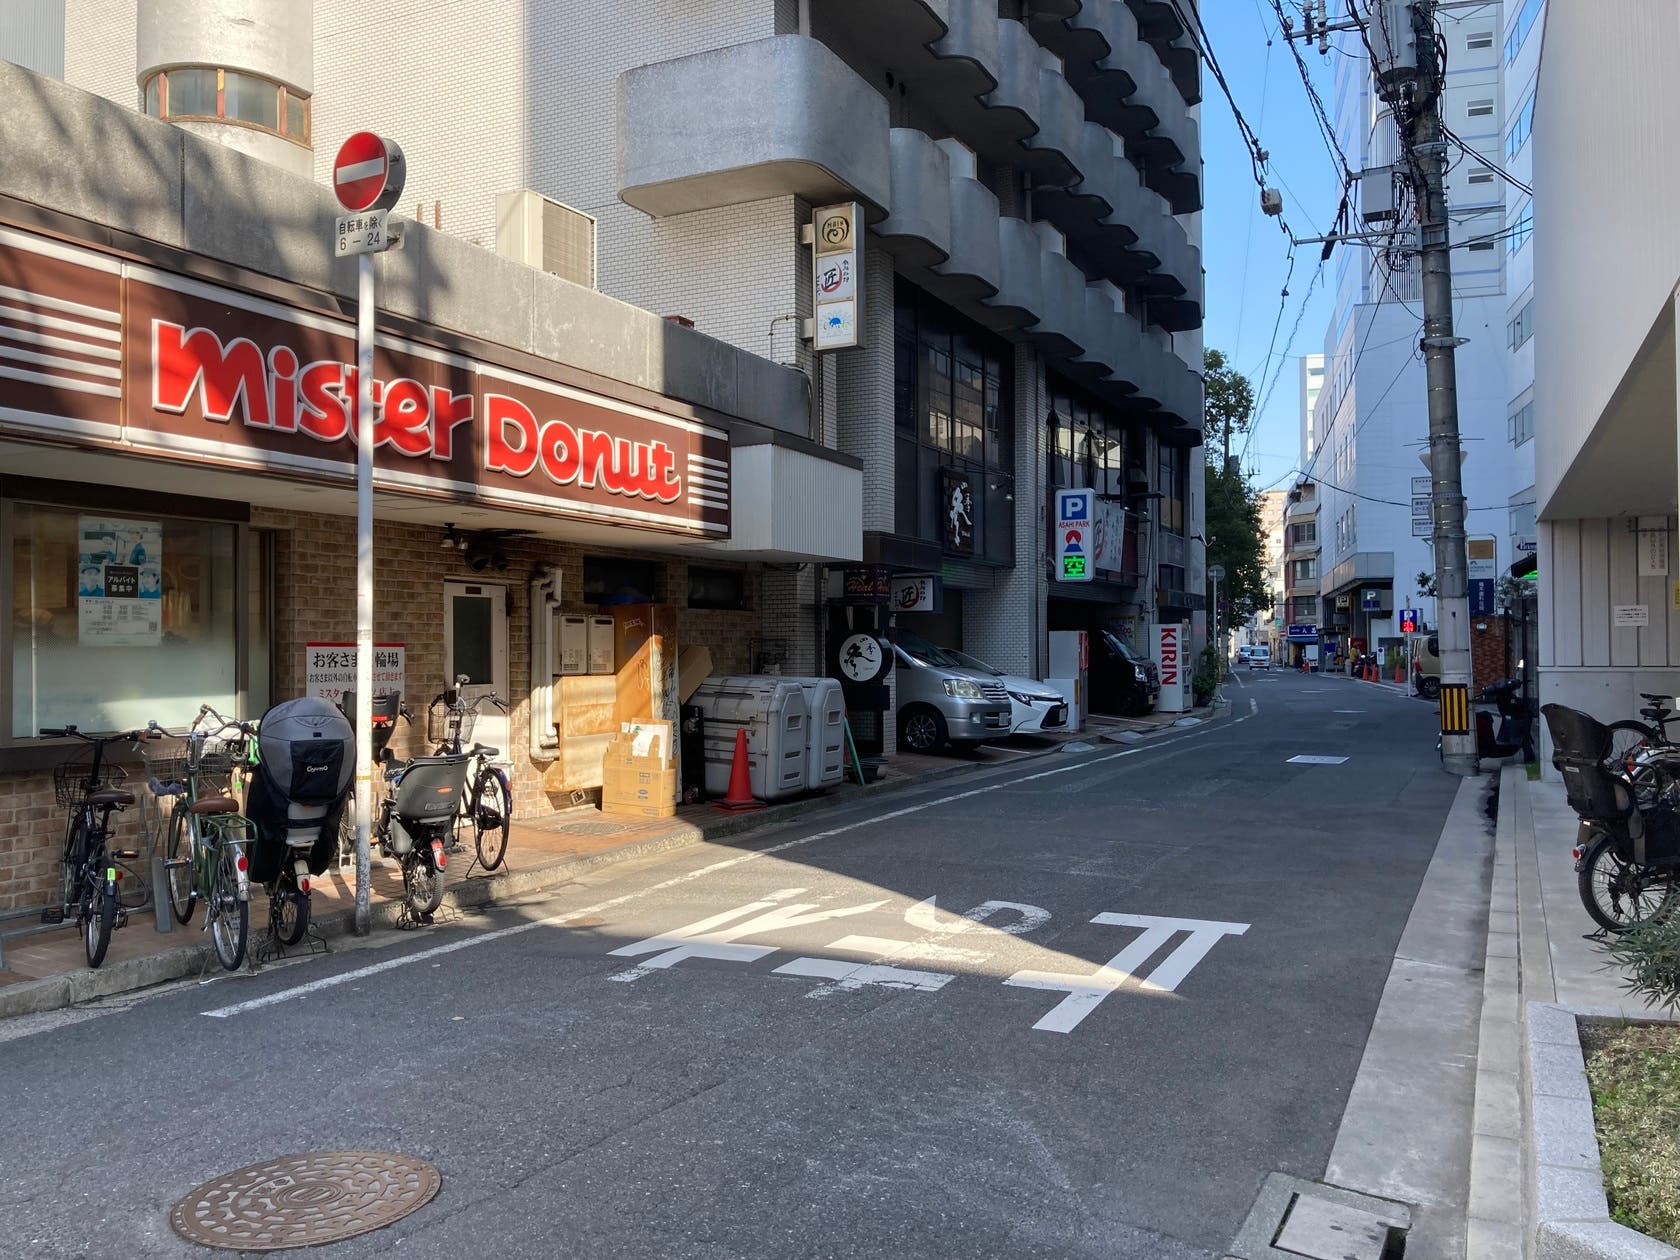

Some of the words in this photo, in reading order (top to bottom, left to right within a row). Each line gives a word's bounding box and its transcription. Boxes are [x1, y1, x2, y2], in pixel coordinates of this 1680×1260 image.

[340, 216, 383, 235] 自転車を除く
[1065, 497, 1083, 518] P
[1059, 521, 1075, 529] ASAHI
[1075, 520, 1090, 528] PARK
[1063, 555, 1086, 578] 空
[107, 575, 136, 584] アルバイト
[313, 651, 399, 668] お客さま輪場
[1161, 627, 1177, 686] KIRIN
